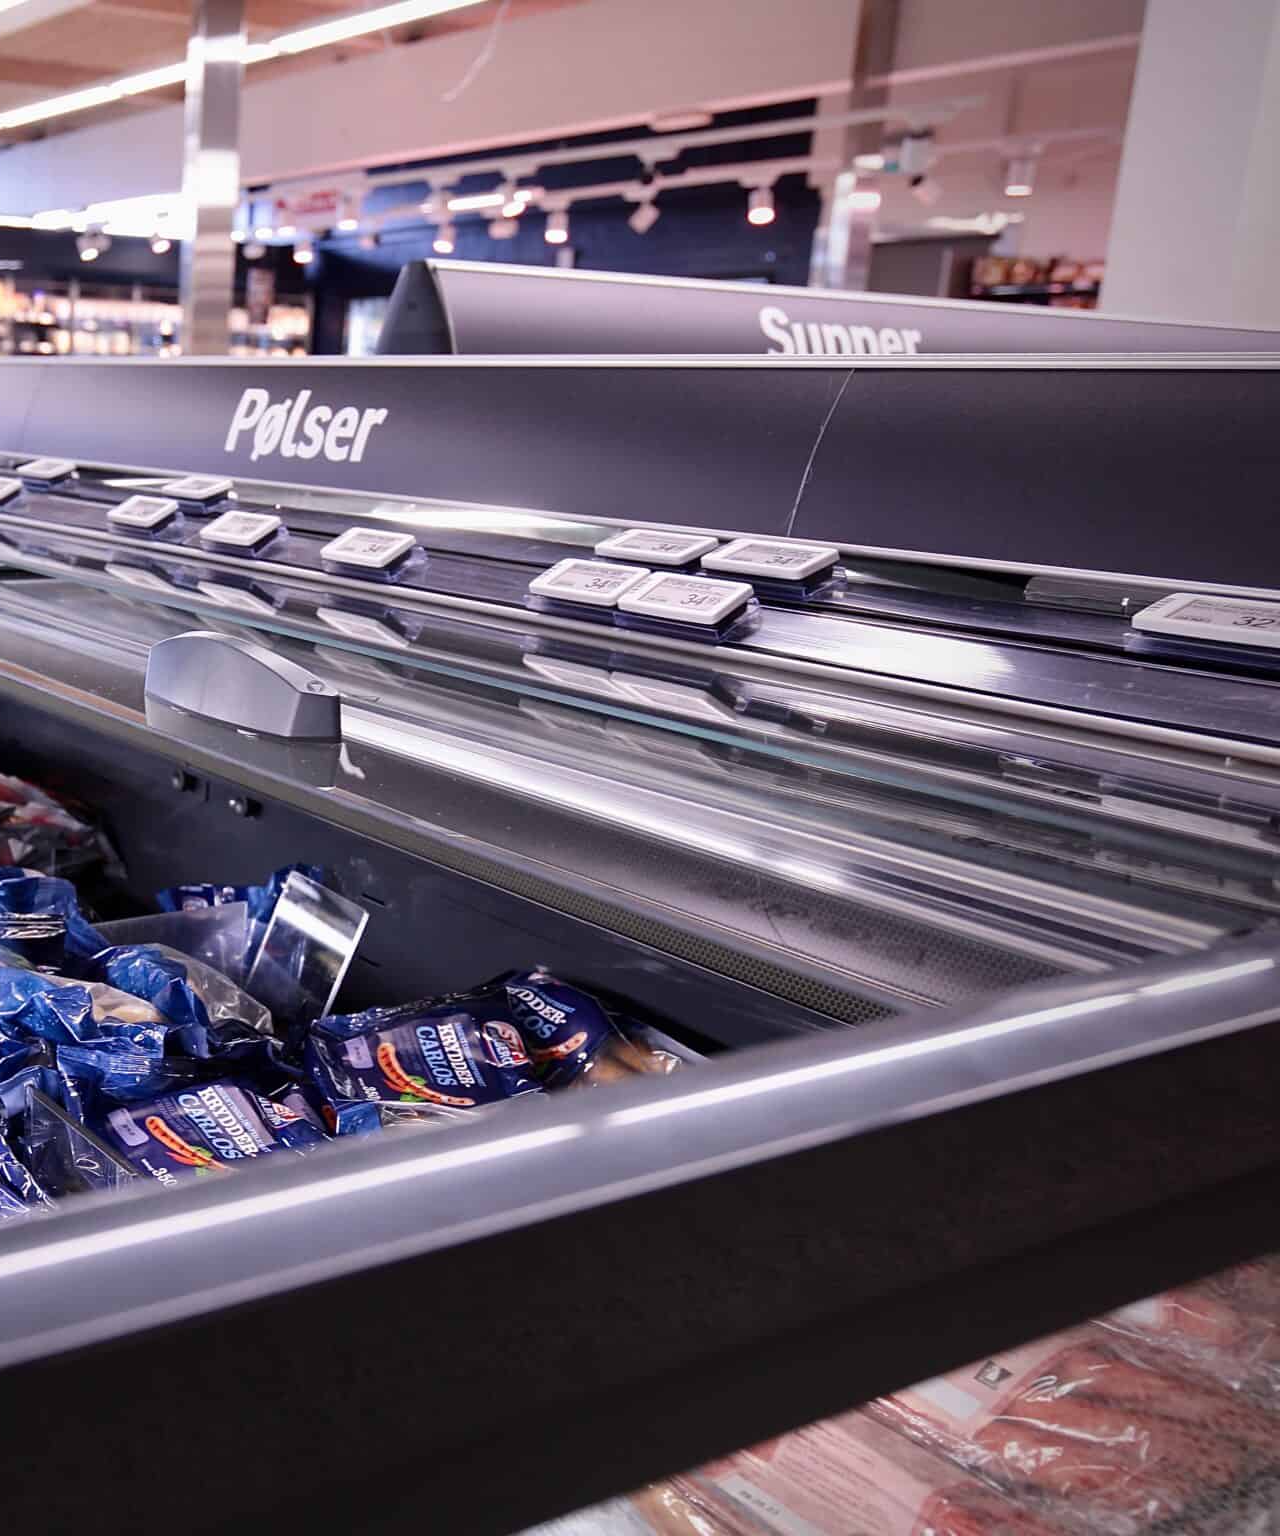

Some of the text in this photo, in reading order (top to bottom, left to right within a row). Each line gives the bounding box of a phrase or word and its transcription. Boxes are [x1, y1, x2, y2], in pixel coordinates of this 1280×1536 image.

[224, 388, 388, 462] Pølser
[416, 1025, 458, 1087] CARLOS
[178, 1094, 246, 1160] CARLOS
